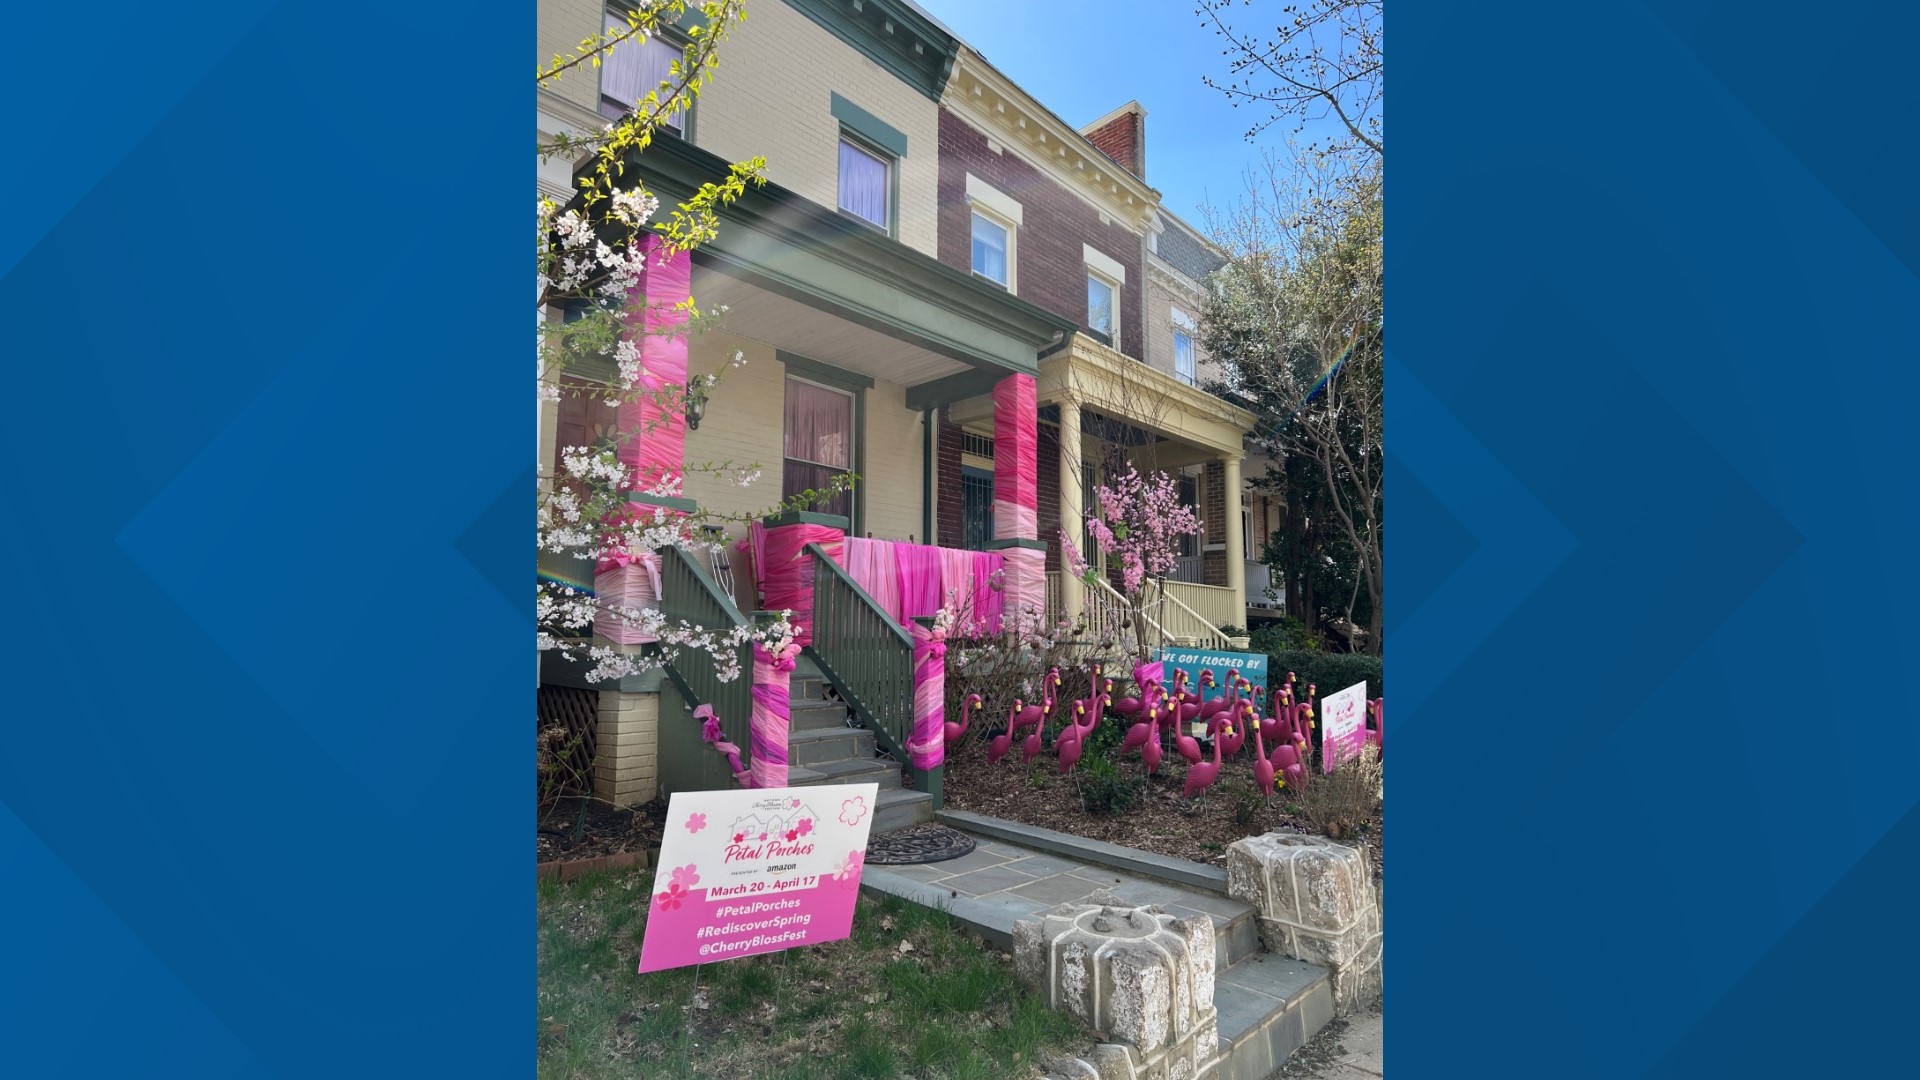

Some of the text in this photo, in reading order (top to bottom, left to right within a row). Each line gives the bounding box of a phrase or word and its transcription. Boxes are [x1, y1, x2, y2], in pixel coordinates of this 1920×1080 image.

[1161, 653, 1260, 669] WE GOT FLOCKED BY
[724, 840, 814, 864] Petal Porches
[766, 863, 797, 873] amazon
[710, 884, 747, 897] March
[749, 881, 765, 892] 20
[772, 877, 800, 891] April
[802, 876, 816, 886] 17
[716, 898, 801, 918] #PetalPorches
[696, 913, 812, 938] #RediscoverSpring
[699, 929, 807, 955] @CherryBlossFest
